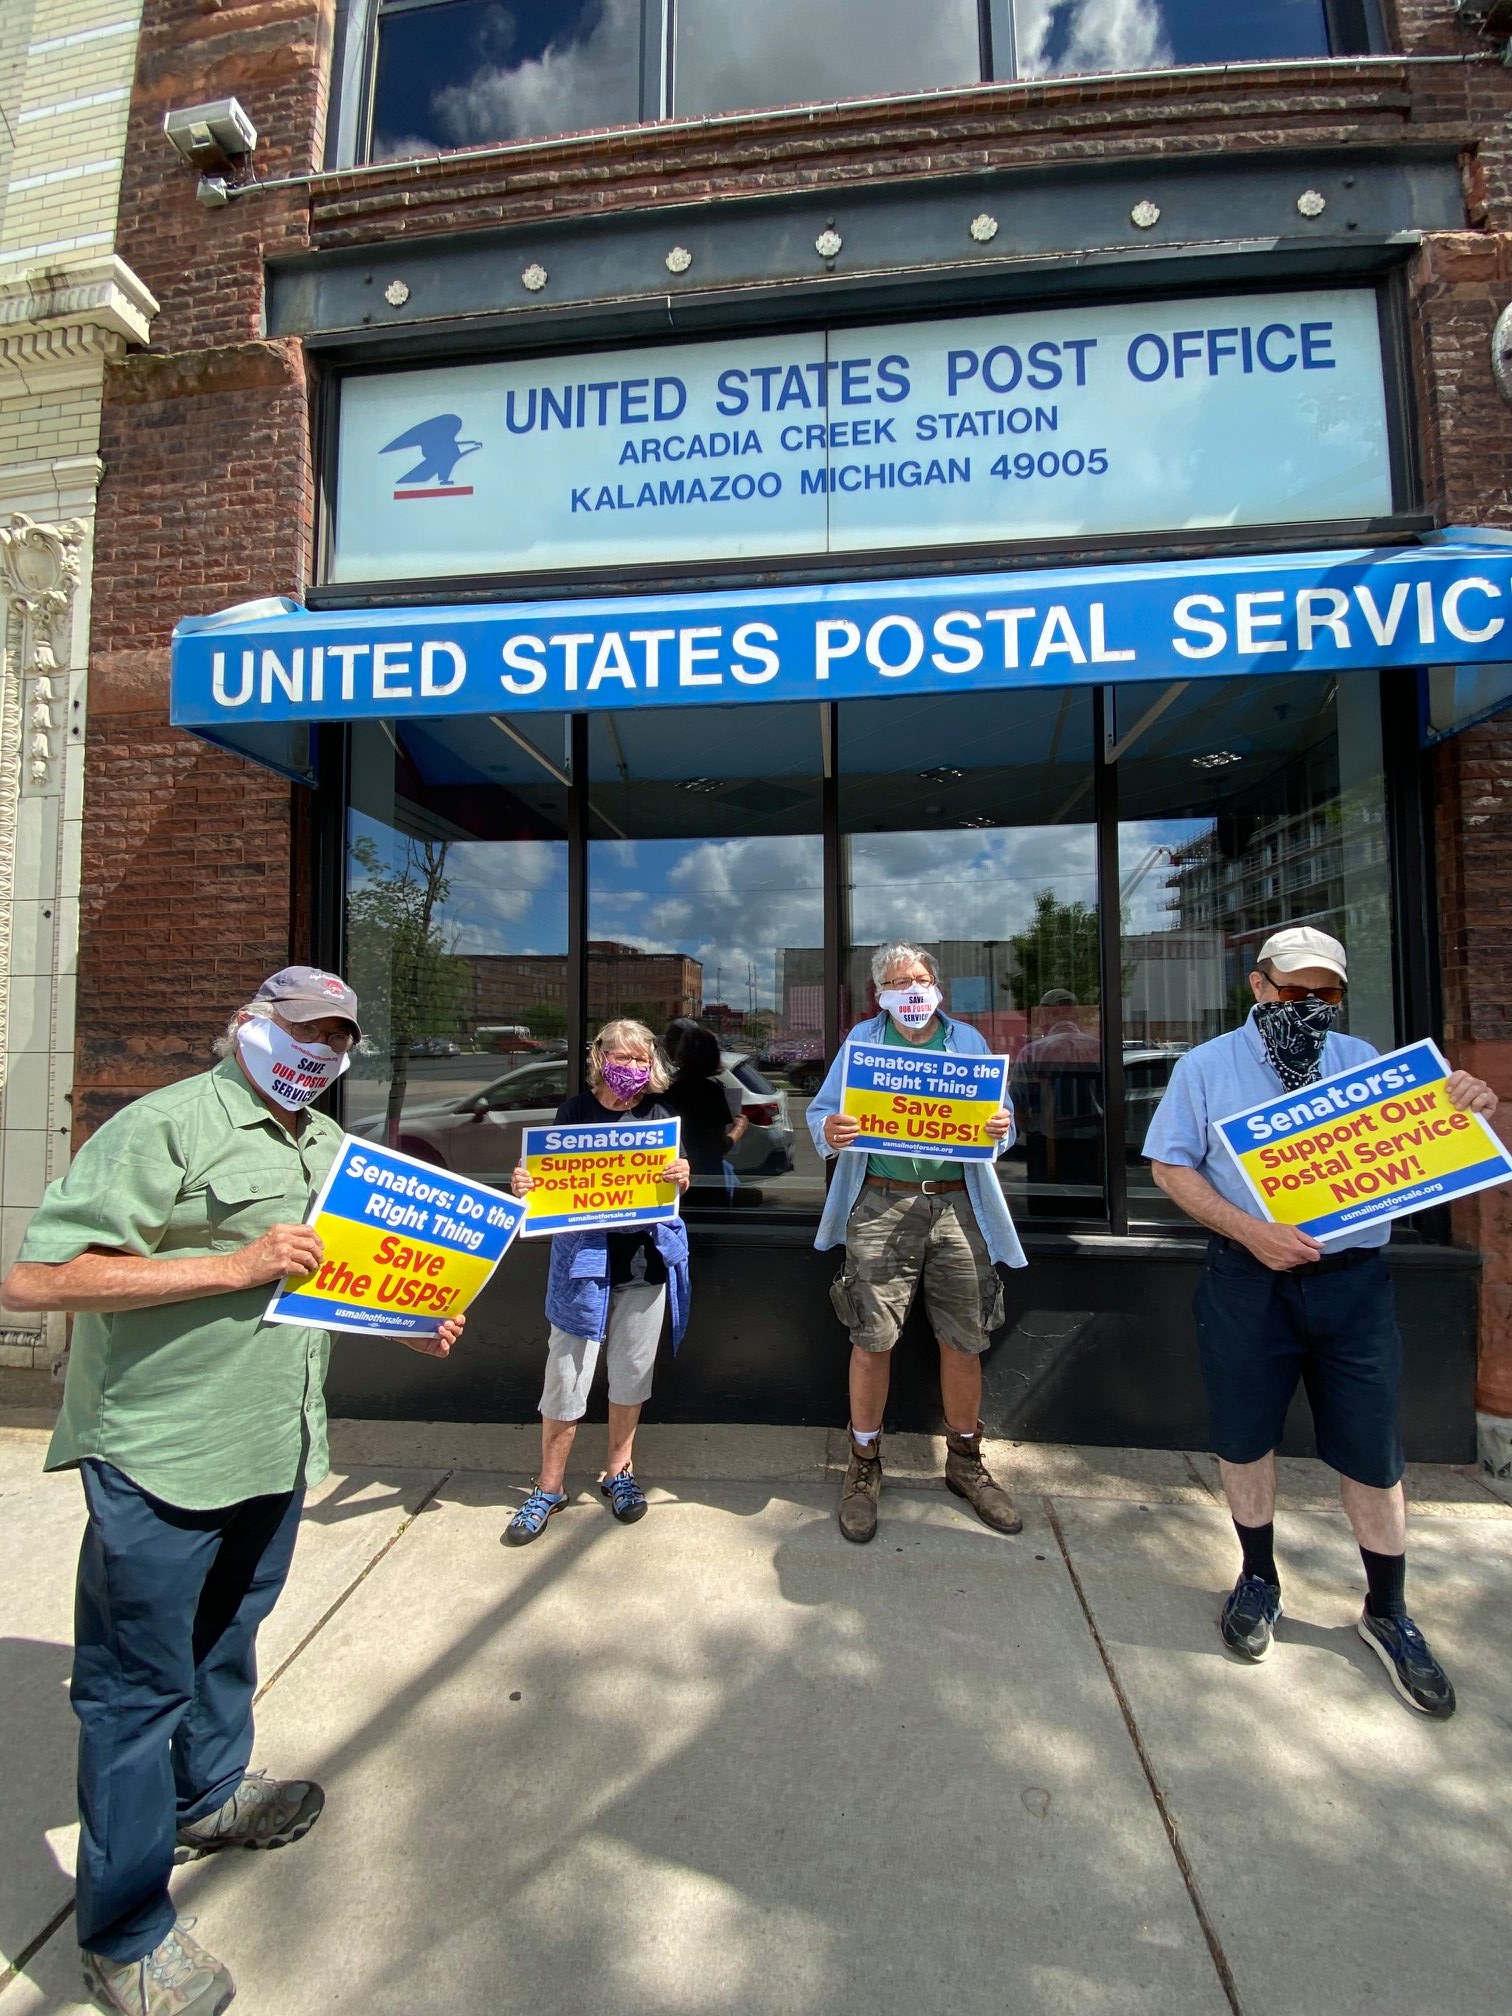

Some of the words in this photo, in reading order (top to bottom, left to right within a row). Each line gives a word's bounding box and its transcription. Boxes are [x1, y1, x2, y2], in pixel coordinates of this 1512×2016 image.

[505, 375, 688, 434] UNITED
[716, 354, 910, 417] STATES
[948, 338, 1097, 397] POST
[1127, 321, 1336, 383] OFFICE
[619, 429, 762, 465] ARCADIA
[780, 419, 896, 451] CREEK
[916, 405, 1058, 441] STATION
[571, 471, 782, 513] KALAMAZOO
[801, 457, 971, 495] MICHIGAN
[990, 447, 1109, 481] 49005
[212, 641, 467, 707] UNITED
[500, 621, 780, 696] STATES
[815, 602, 1136, 681] POSTAL
[1172, 577, 1512, 659] SERVIC
[898, 1005, 912, 1013] OUR
[272, 1062, 296, 1081] OUR
[297, 1057, 326, 1074] SAVE
[853, 1052, 937, 1074] Senators:
[943, 1062, 968, 1077] Do
[973, 1064, 1000, 1079] the
[873, 1072, 921, 1091] Right
[927, 1080, 978, 1097] Thing
[892, 1096, 953, 1118] Save
[1246, 1063, 1417, 1140] Senators:
[545, 1130, 663, 1150] Senators:
[860, 1114, 899, 1135] the
[907, 1118, 980, 1142] USPS!
[1260, 1113, 1378, 1169] Support
[1380, 1091, 1437, 1124] Our
[883, 1140, 953, 1154] usmailnotforsale.org
[1261, 1150, 1350, 1198] Postal
[1360, 1113, 1471, 1164] Service
[540, 1154, 625, 1173] Support
[630, 1152, 667, 1167] Our
[346, 1155, 456, 1210] Senators:
[456, 1194, 485, 1219] Do
[486, 1206, 515, 1231] the
[530, 1173, 595, 1192] Postal
[1329, 1154, 1426, 1204] NOW!
[573, 1190, 634, 1209] NOW!
[1340, 1182, 1443, 1222] usmailnotforsale.org
[364, 1192, 429, 1231] Right
[433, 1214, 485, 1250] Thing
[568, 1210, 637, 1223] usmailnotforsale.org
[373, 1236, 445, 1277] Save
[315, 1260, 372, 1297] the
[377, 1273, 461, 1312] USPS!
[335, 1308, 415, 1327] usmailnotforsale.org
